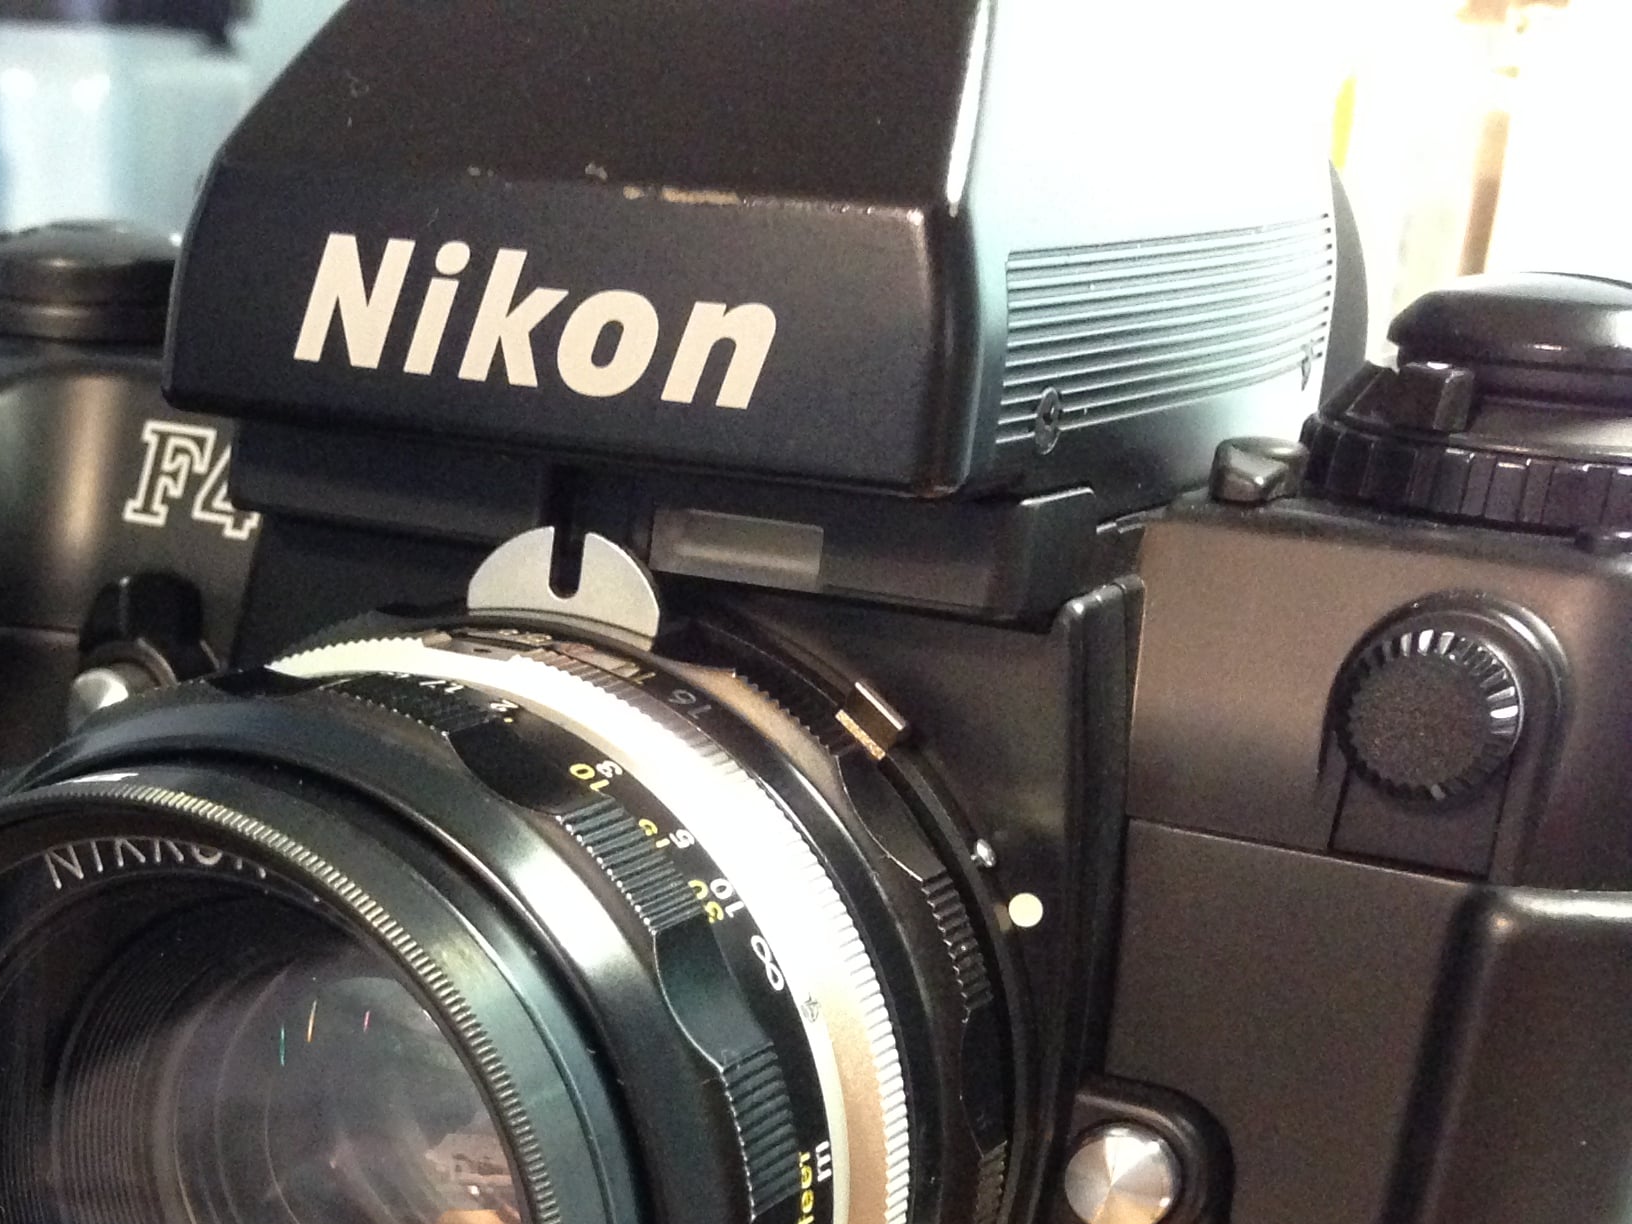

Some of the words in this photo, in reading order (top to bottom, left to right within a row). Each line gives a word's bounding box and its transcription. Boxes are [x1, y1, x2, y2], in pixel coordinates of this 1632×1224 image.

[293, 232, 777, 409] Nikon
[123, 419, 261, 541] F4
[569, 763, 610, 792] 10
[669, 828, 695, 849] 5
[709, 878, 745, 918] 10
[815, 1140, 833, 1182] m
